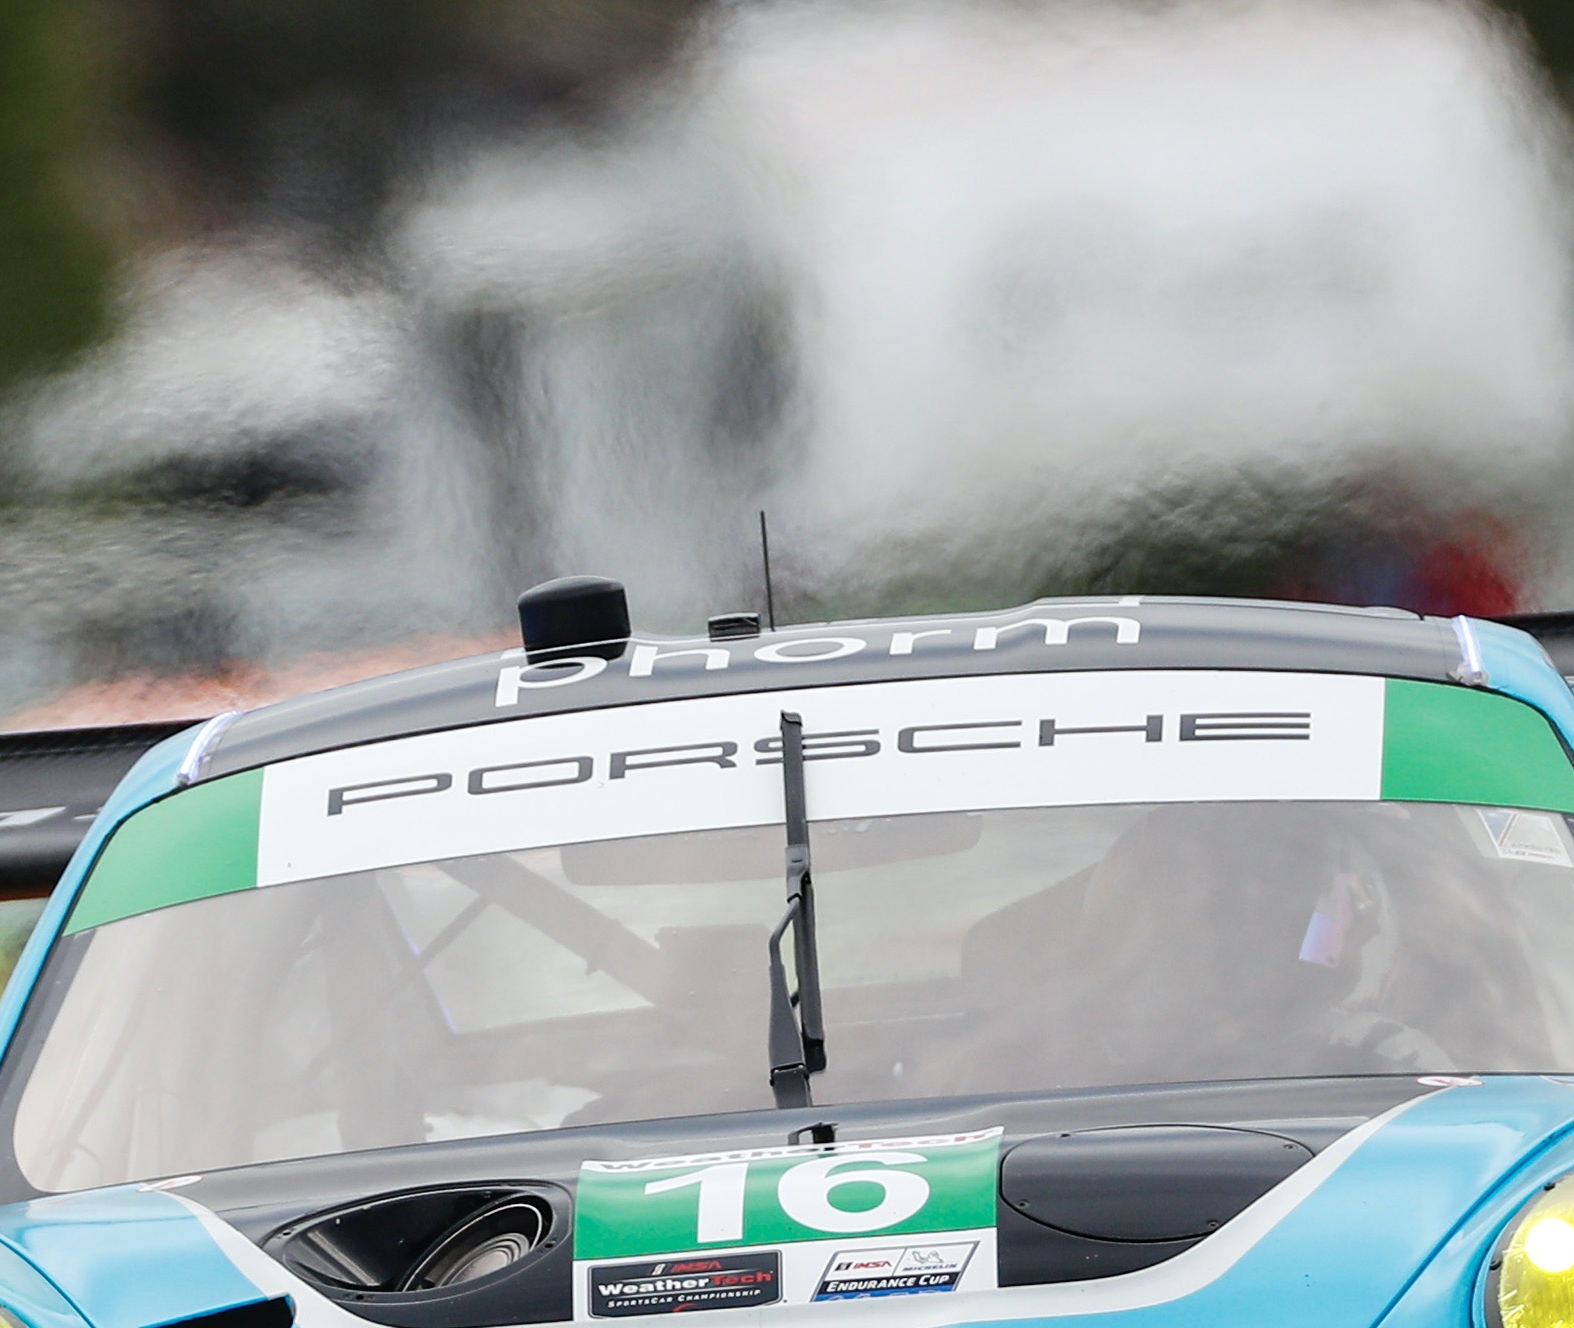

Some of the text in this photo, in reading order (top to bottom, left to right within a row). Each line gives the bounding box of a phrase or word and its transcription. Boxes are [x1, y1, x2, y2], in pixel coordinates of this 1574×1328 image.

[495, 615, 1141, 708] phorm
[326, 711, 1312, 817] PORSCHE
[644, 1151, 931, 1244] 16
[670, 1259, 723, 1273] IMSA
[852, 1260, 893, 1271] IMSA
[902, 1263, 958, 1272] MICHELIN
[598, 1271, 773, 1297] WeatherTech
[826, 1273, 950, 1293] ENDURANCE CUP
[677, 1289, 762, 1303] CHAMPIONSHIP
